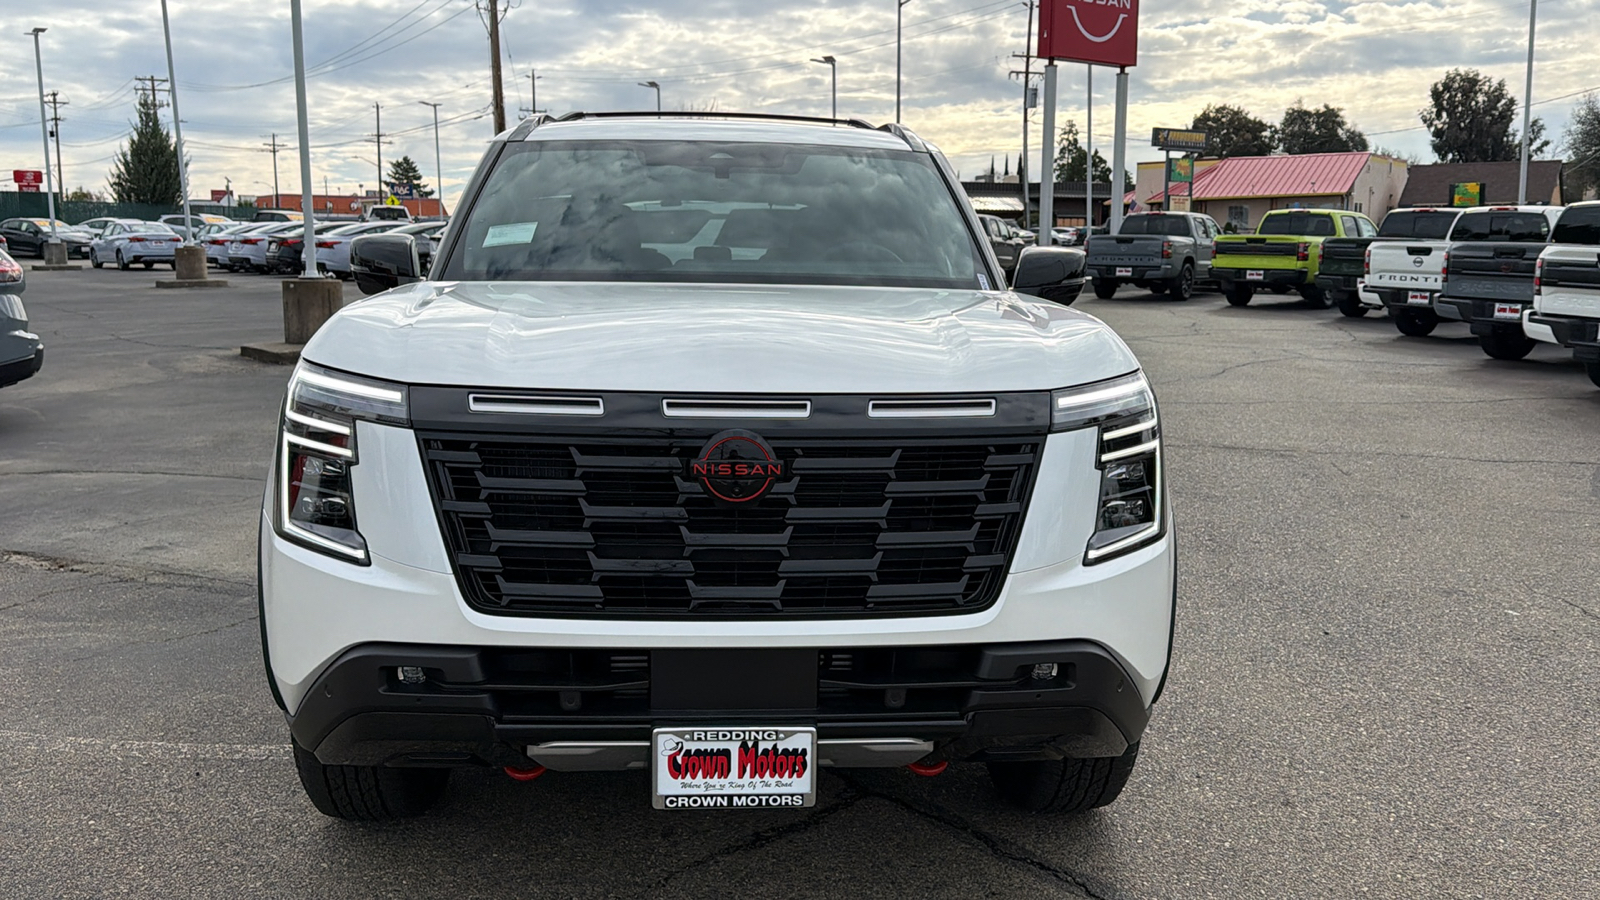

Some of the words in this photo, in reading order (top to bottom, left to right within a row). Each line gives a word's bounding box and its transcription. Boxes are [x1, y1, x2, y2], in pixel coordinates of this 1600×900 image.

[693, 464, 781, 475] NISSAN
[693, 731, 777, 741] REDDING
[667, 743, 731, 780] Crown
[737, 741, 808, 780] Motors
[680, 781, 702, 789] Where
[703, 781, 726, 790] You're
[728, 781, 746, 790] King
[747, 780, 757, 790] Of
[759, 780, 772, 788] The
[665, 796, 728, 808] CROWN
[732, 795, 803, 807] MOTORS
